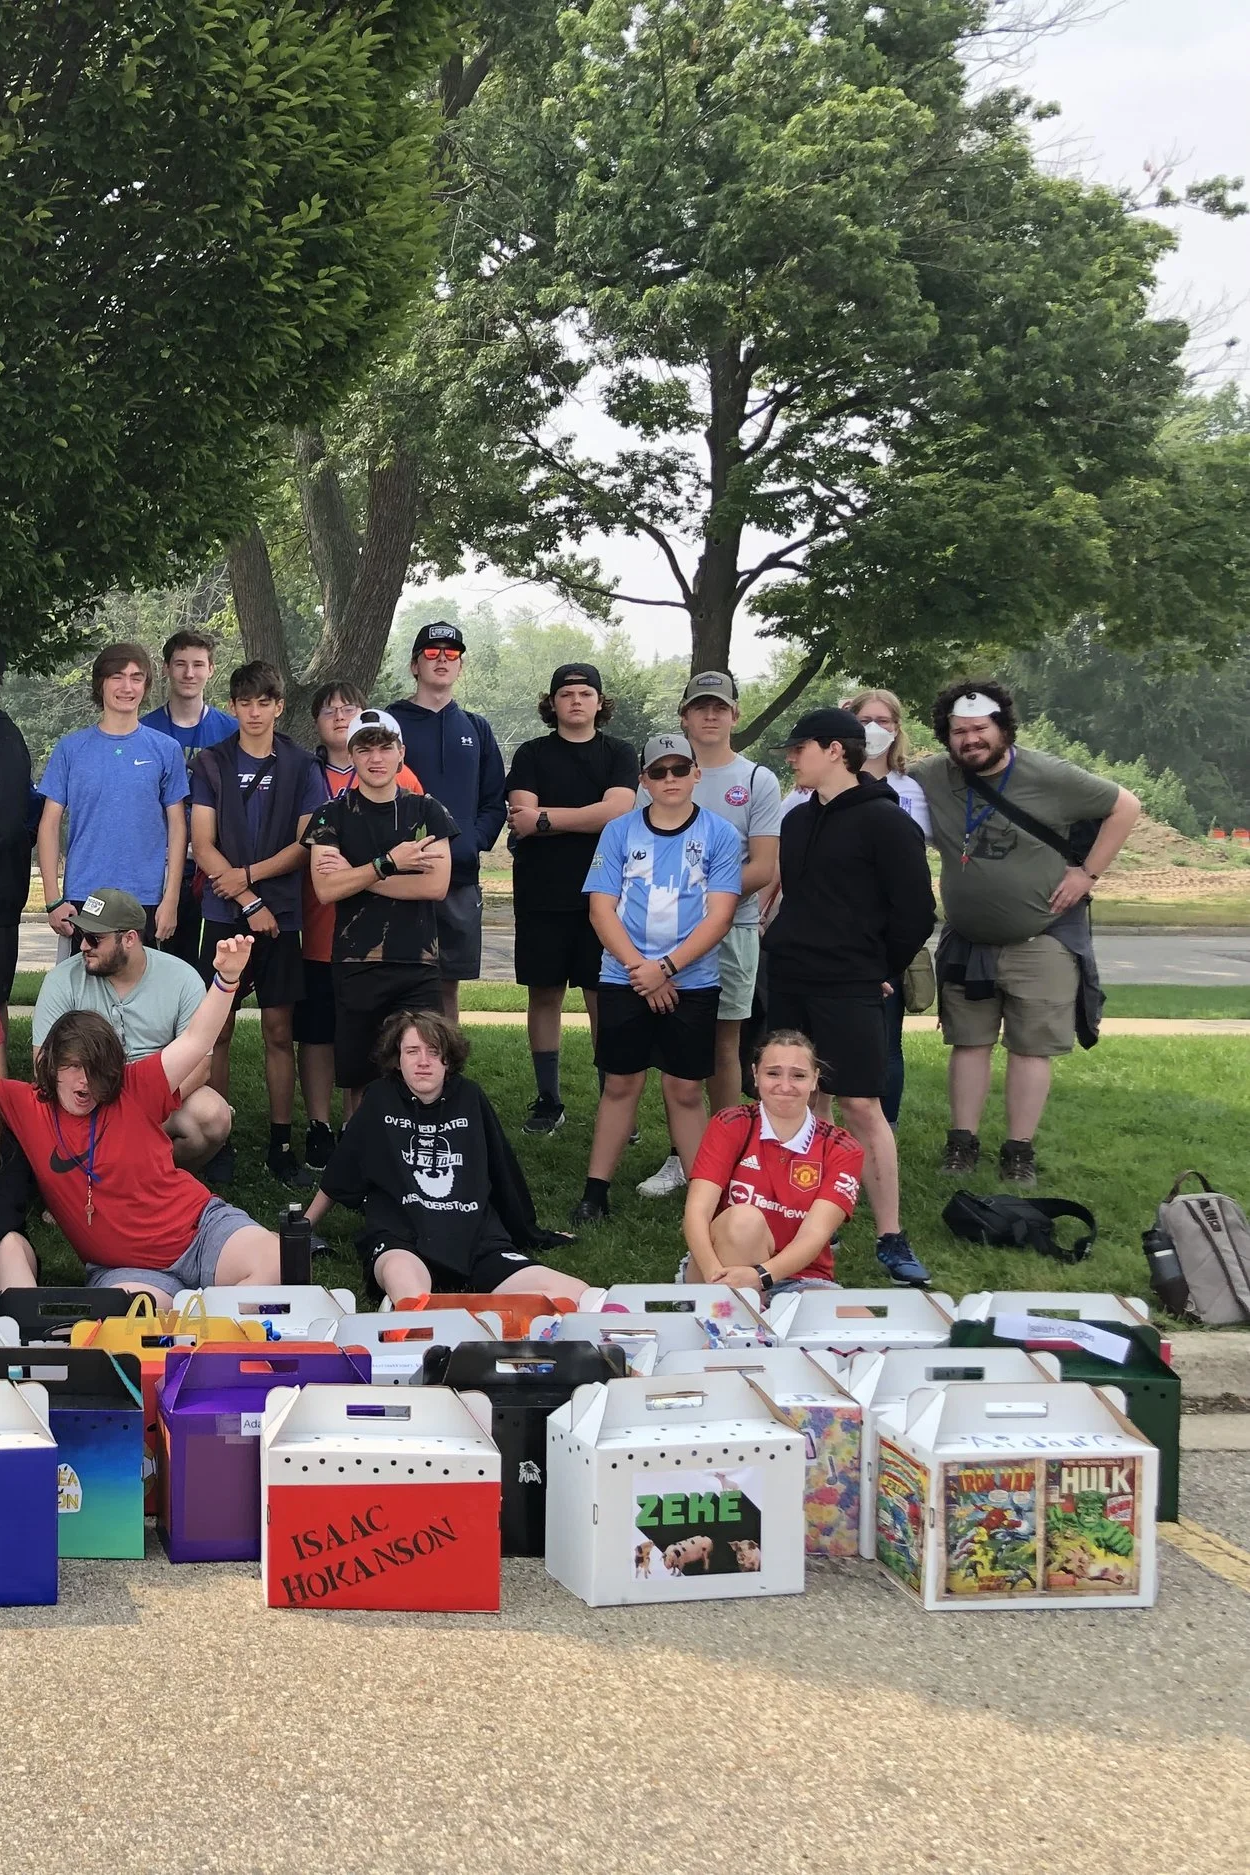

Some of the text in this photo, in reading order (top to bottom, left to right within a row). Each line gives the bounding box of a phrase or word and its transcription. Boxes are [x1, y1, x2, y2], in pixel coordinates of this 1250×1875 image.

[384, 1115, 412, 1129] OVER
[753, 1193, 809, 1219] TeamView
[1061, 1466, 1132, 1495] HULK
[635, 1490, 742, 1527] ZEKE
[291, 1505, 390, 1561] ISAAC
[281, 1516, 459, 1604] HOKANSON
